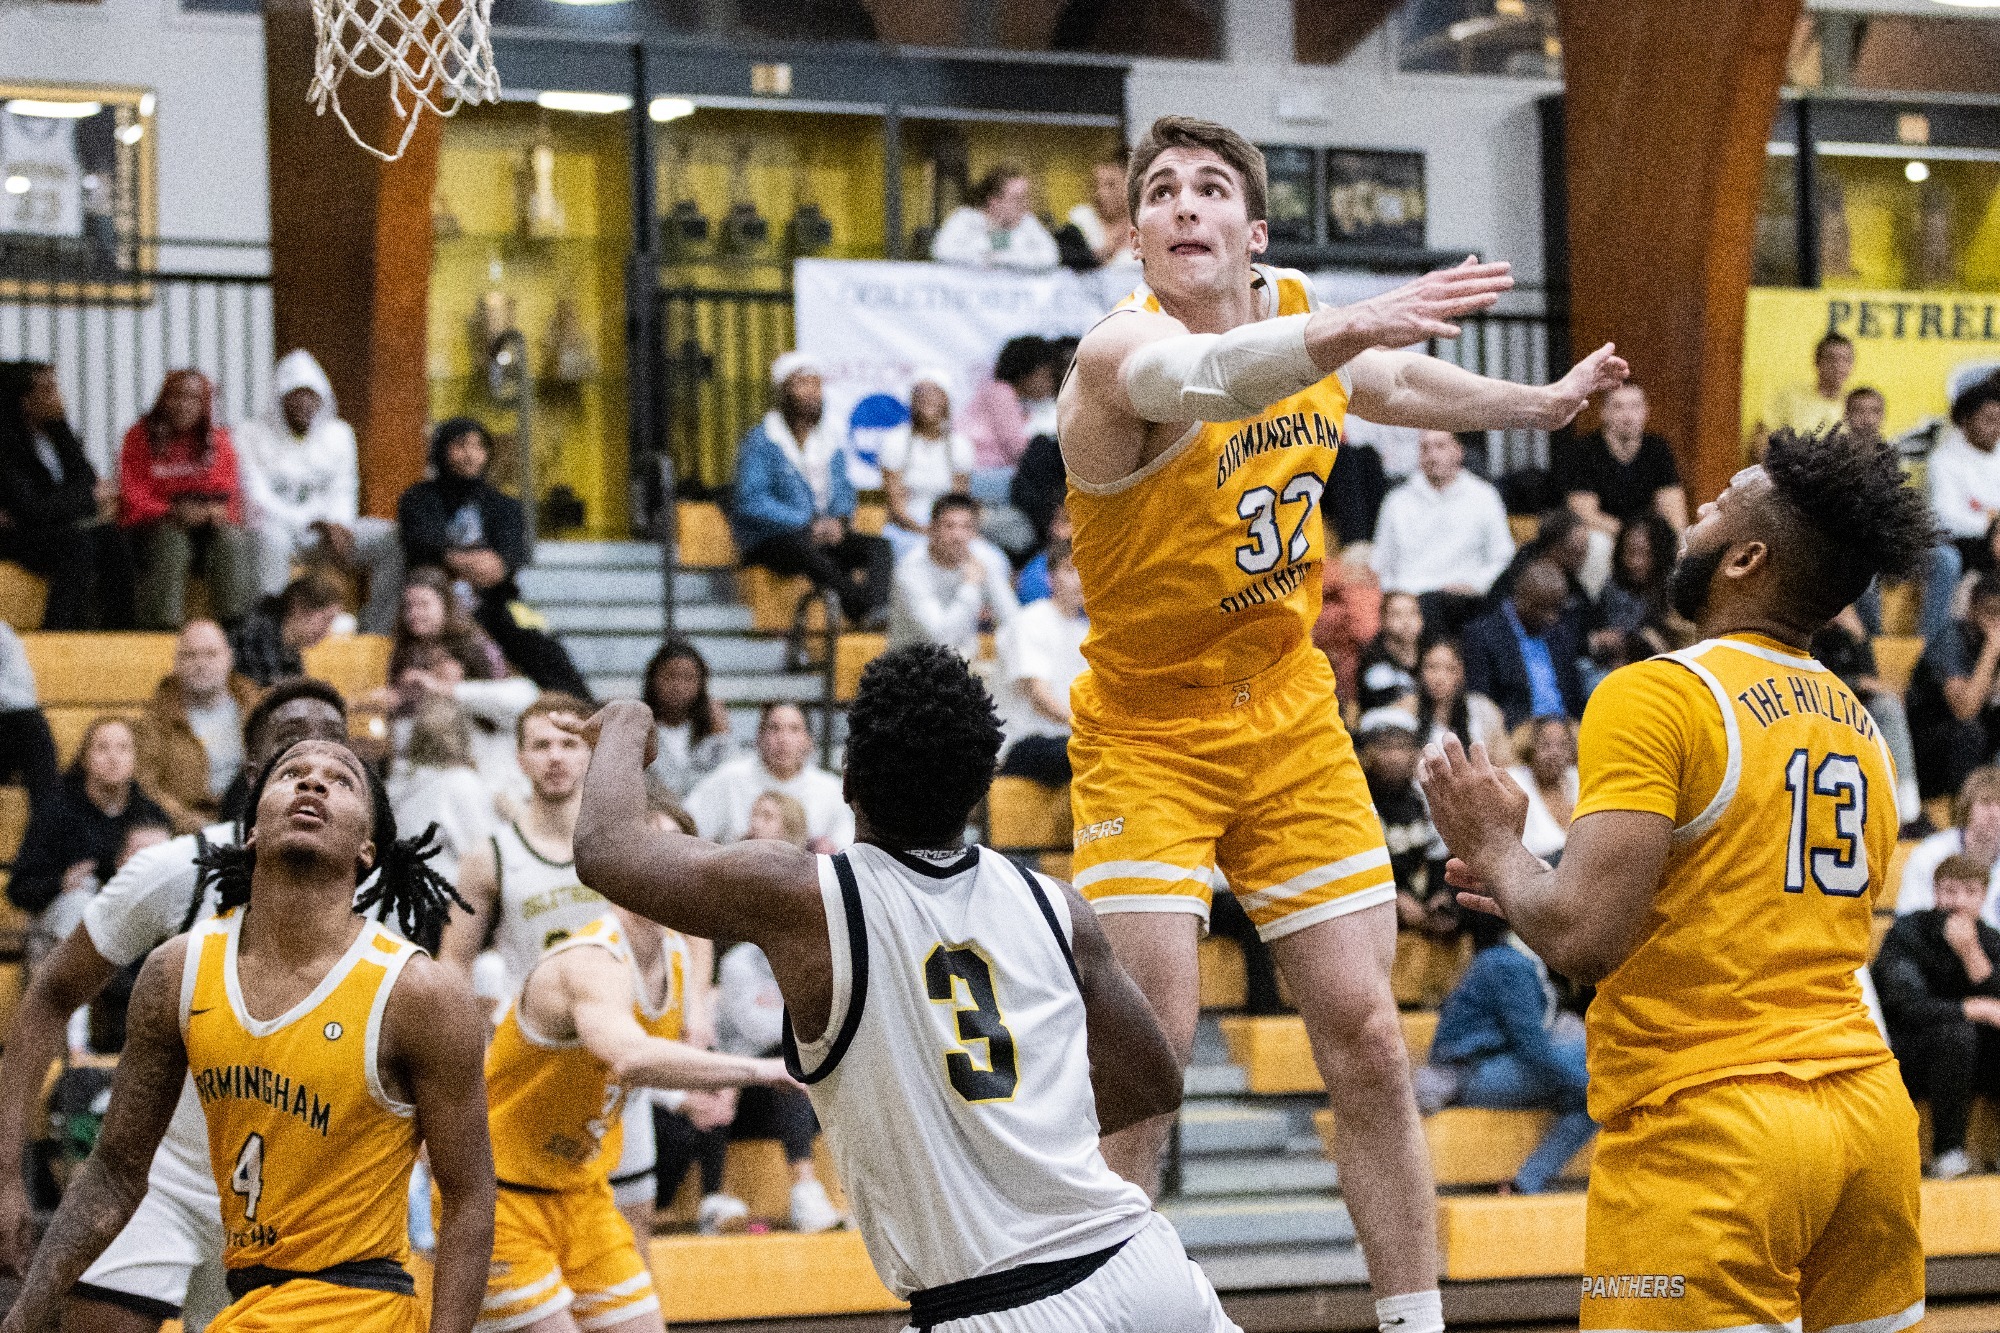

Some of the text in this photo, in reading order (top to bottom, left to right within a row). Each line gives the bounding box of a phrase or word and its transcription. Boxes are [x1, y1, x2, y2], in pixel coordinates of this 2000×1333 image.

[1216, 412, 1340, 489] BIRMINGHAM
[1235, 471, 1326, 576] 32
[1738, 677, 1790, 728] THE
[1783, 747, 1869, 898] 13
[921, 941, 1021, 1104] 3
[231, 1131, 265, 1222] 4
[1580, 1274, 1686, 1299] PANTHERS
